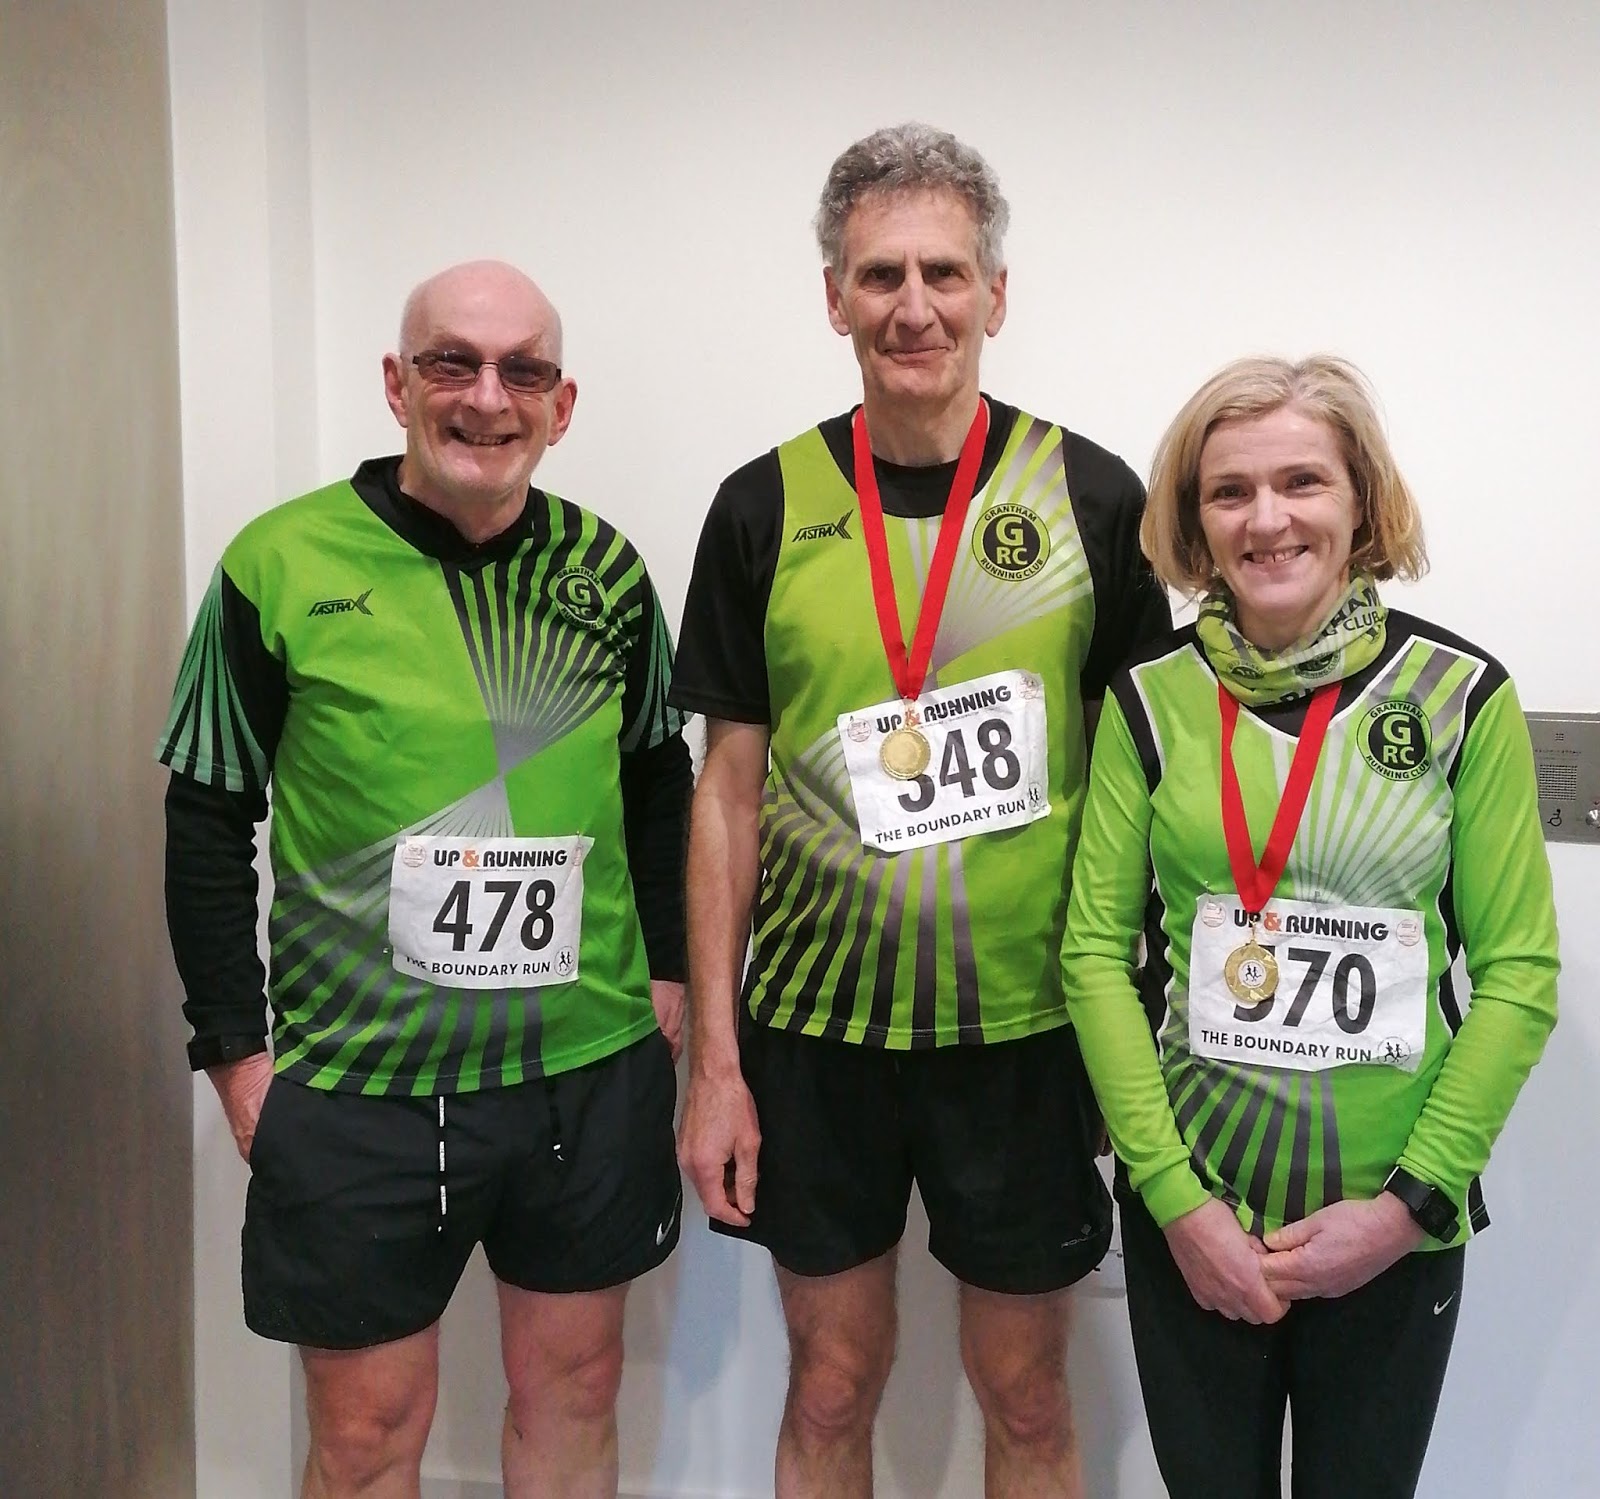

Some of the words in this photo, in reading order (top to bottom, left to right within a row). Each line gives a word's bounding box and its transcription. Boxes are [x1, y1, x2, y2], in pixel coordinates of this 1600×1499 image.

[985, 506, 1037, 522] GRANTHAM
[996, 516, 1023, 546] G
[996, 546, 1028, 565] RC
[557, 567, 600, 586] GRANTHAM
[980, 558, 1022, 579] RUNNING
[1023, 559, 1043, 577] CLUB
[567, 577, 591, 606] G
[1343, 610, 1385, 632] CLUB
[876, 714, 902, 734] UP
[923, 685, 1012, 723] RUNNING
[1370, 702, 1424, 720] GRANTHAM
[1382, 713, 1412, 745] G
[1383, 744, 1415, 765] RC
[1366, 755, 1409, 779] RUNNING
[1410, 759, 1430, 777] CLUB
[875, 829, 903, 845] THE
[907, 806, 992, 837] BOUNDARY
[998, 799, 1027, 817] RUN
[434, 849, 461, 867] UP
[462, 849, 480, 868] &
[482, 849, 568, 868] RUNNING
[432, 879, 556, 953] 478
[1234, 909, 1262, 928] UP
[1263, 912, 1281, 932] &
[1285, 915, 1389, 941] RUNNING
[432, 962, 518, 977] BOUNDARY
[522, 961, 550, 975] RUN
[1201, 1030, 1229, 1046] THE
[1234, 1036, 1330, 1059] BOUNDARY
[1335, 1047, 1372, 1063] RUN
